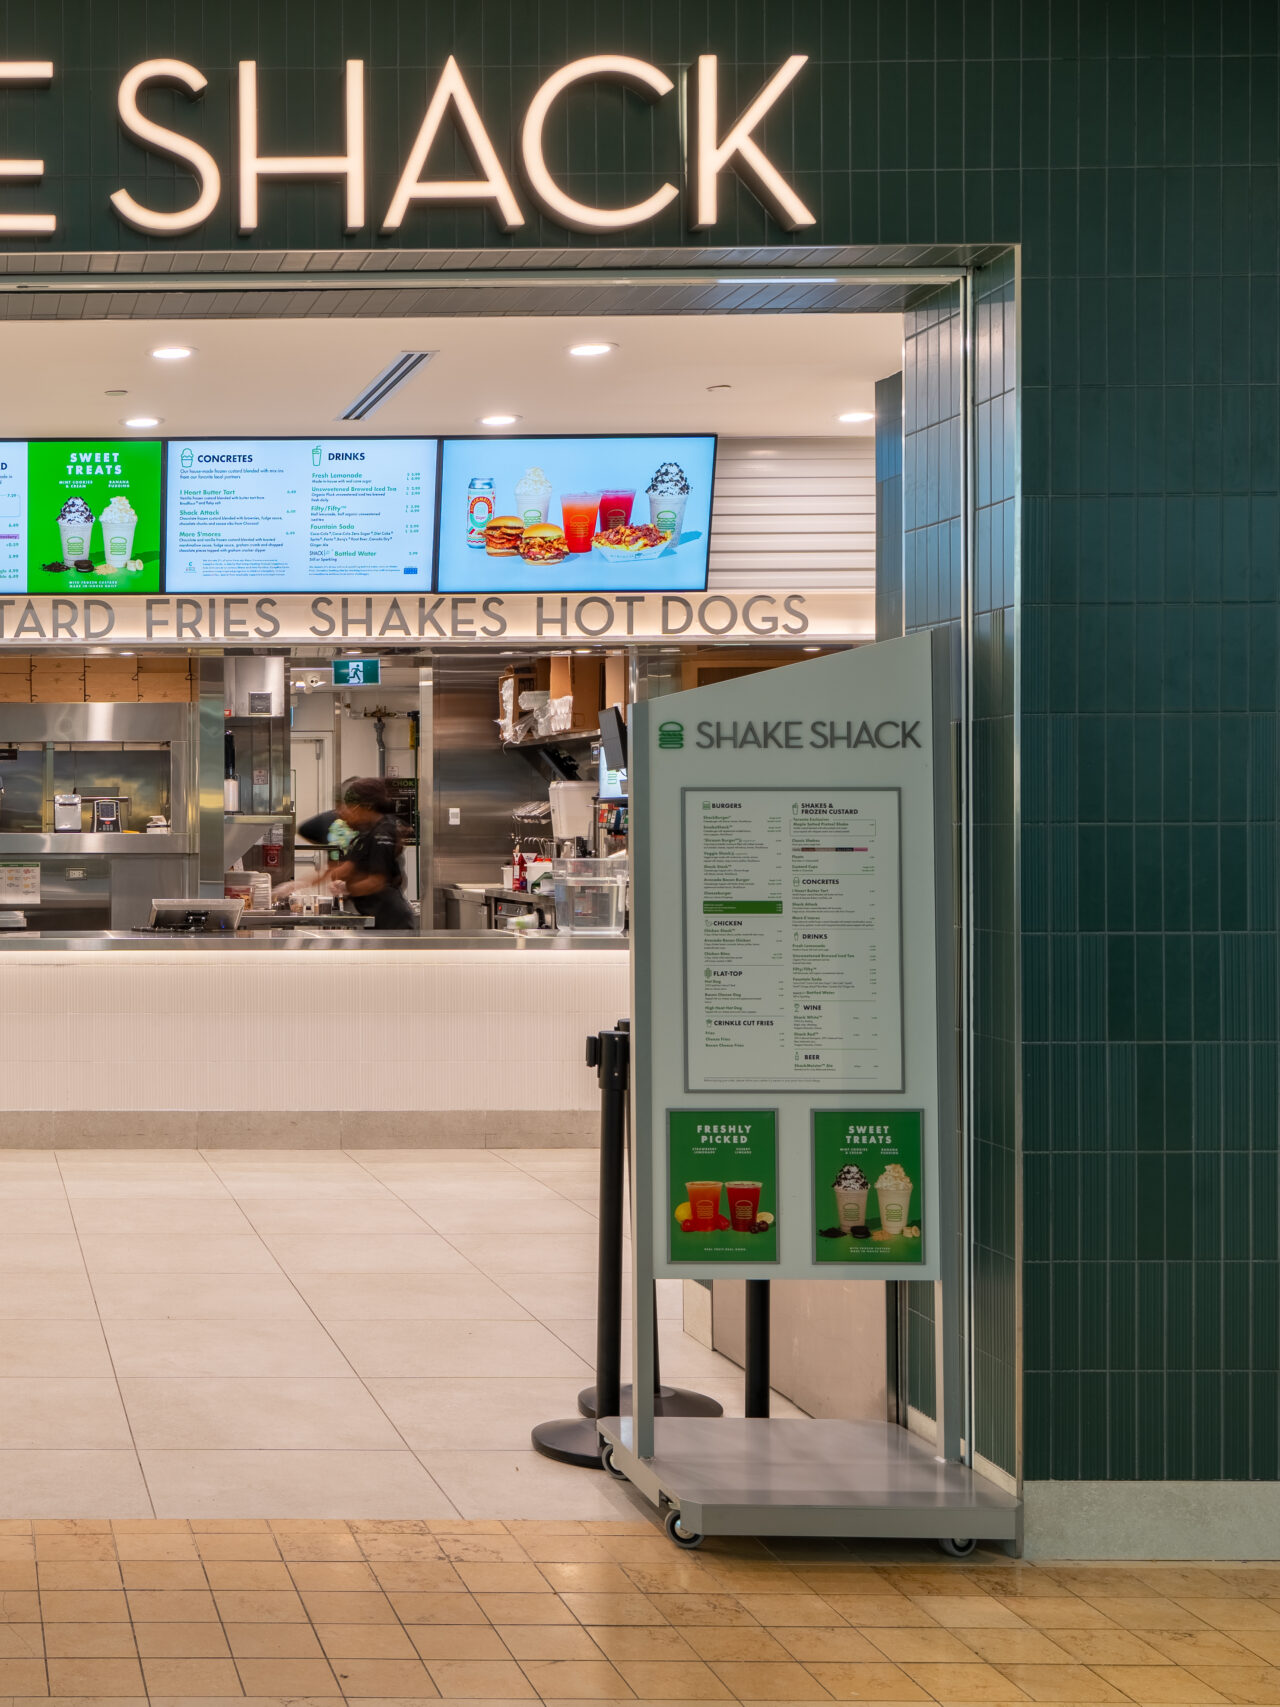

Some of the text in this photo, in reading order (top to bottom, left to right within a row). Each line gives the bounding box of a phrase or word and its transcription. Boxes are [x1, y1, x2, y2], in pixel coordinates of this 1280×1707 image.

[110, 54, 817, 234] SHACK
[70, 453, 119, 462] SWEET
[67, 465, 122, 475] TREATS
[146, 598, 280, 638] FRIES
[310, 597, 508, 638] SHAKES
[537, 596, 645, 636] HOT
[662, 595, 809, 635] DOGS
[696, 721, 922, 749] SHAKE SHACK
[697, 1125, 752, 1133] FRESHLY
[849, 1126, 889, 1134] SWEET
[701, 1135, 748, 1144] PICKED
[846, 1136, 892, 1144] TREATS
